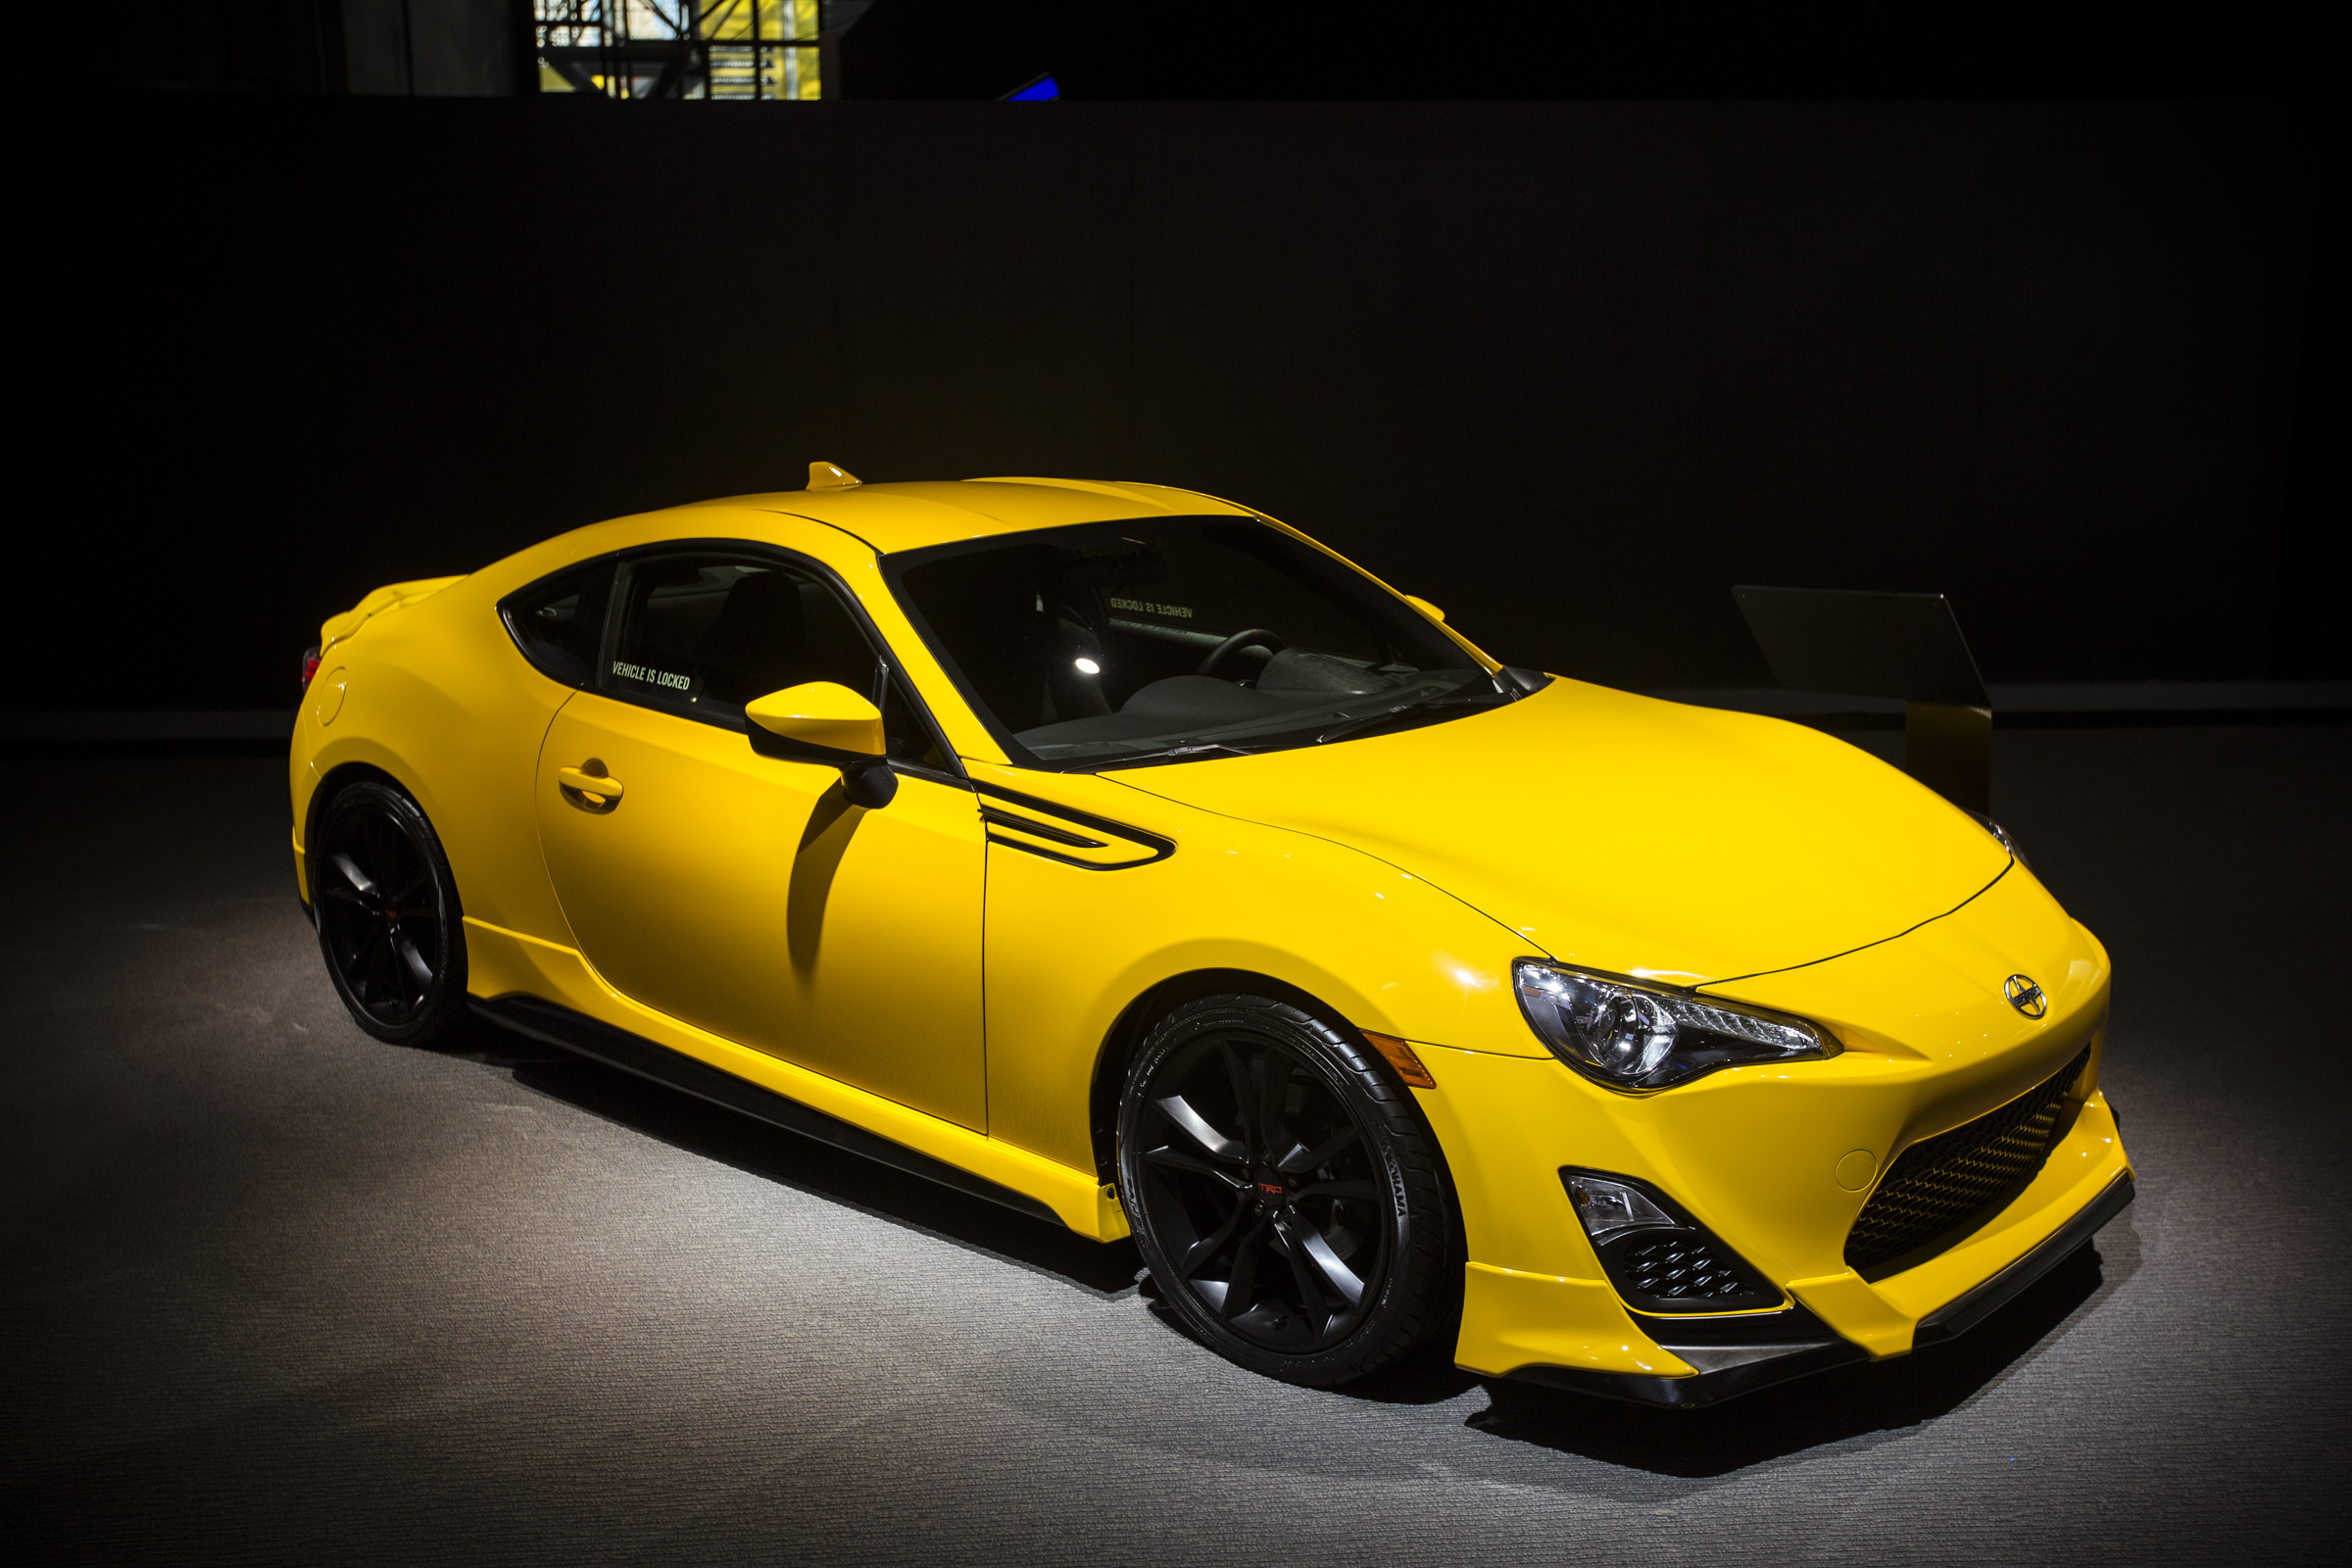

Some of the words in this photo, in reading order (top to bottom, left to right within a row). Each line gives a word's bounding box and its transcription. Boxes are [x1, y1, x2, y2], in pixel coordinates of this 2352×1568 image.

[612, 661, 646, 681] VEHICLE
[646, 668, 657, 683] IS
[657, 670, 690, 691] LOCKED
[1258, 1182, 1283, 1195] TRD
